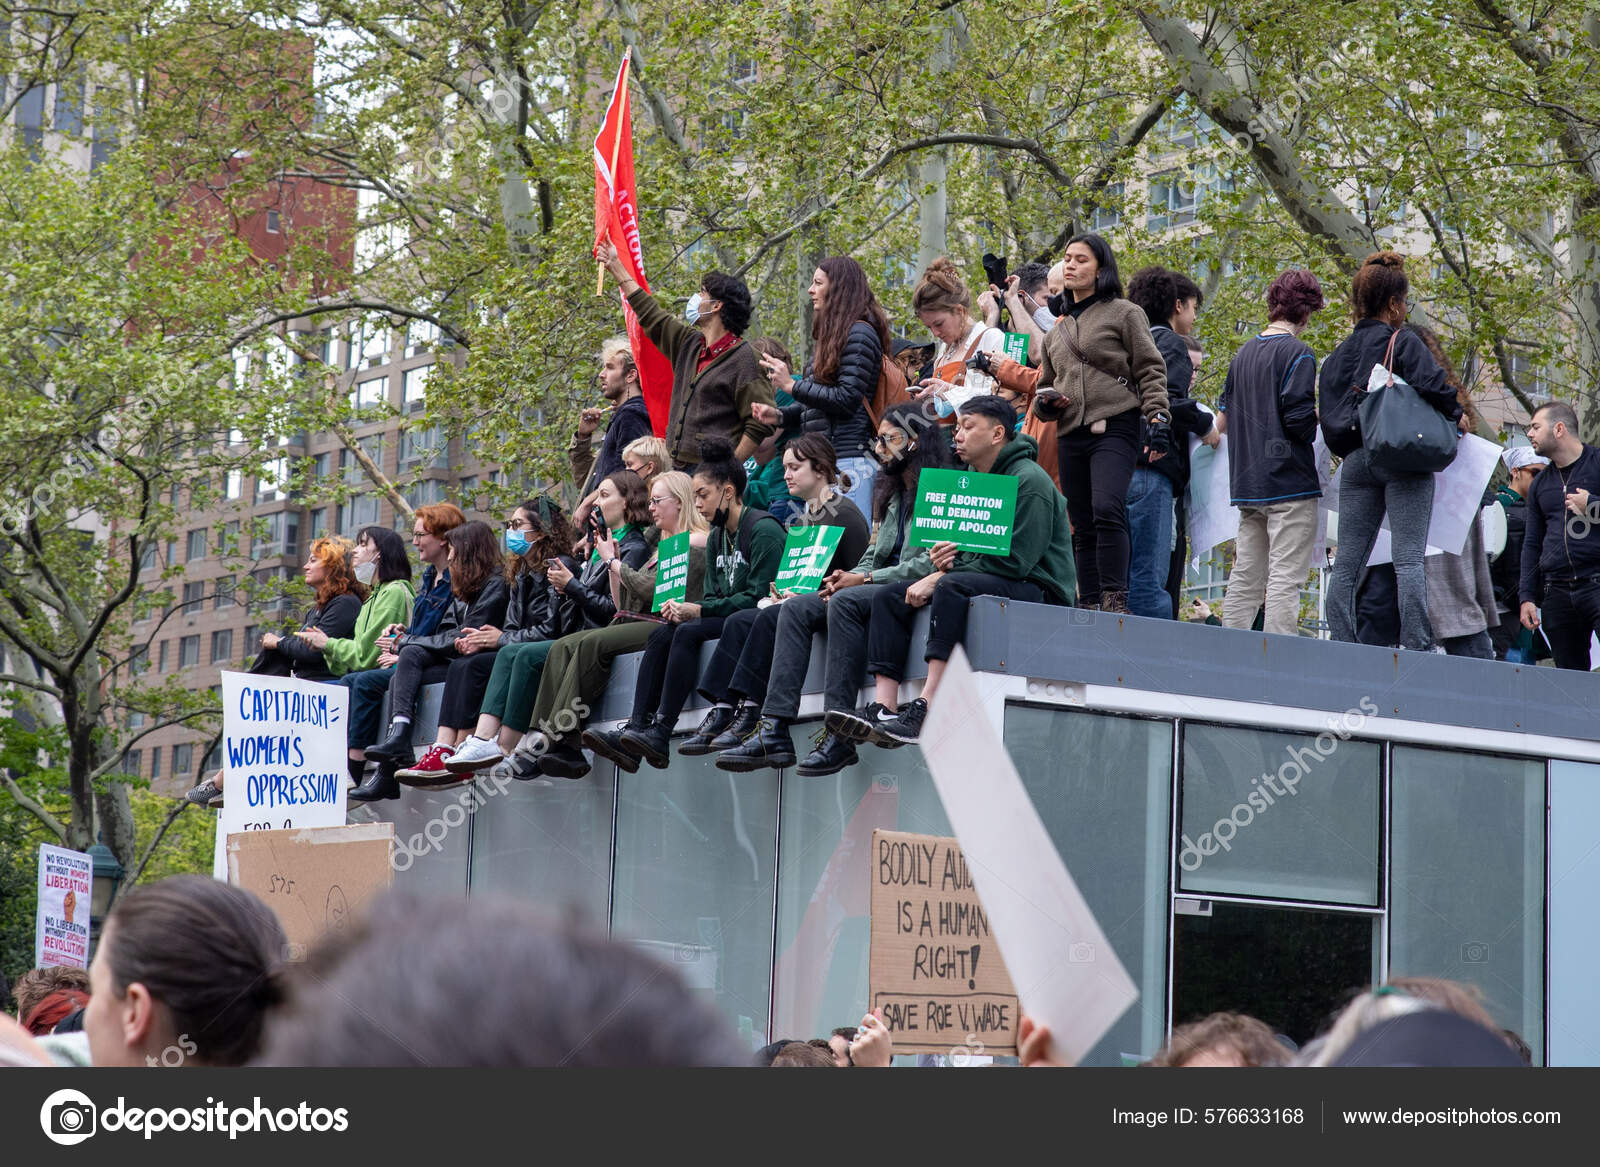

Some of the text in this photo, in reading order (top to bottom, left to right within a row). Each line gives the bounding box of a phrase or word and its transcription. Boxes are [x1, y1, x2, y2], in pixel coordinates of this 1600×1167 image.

[925, 492, 1003, 510] FREE ABORTION
[931, 505, 991, 521] ON DEMAND
[915, 517, 1009, 536] WITHOUT APOLOGY
[227, 728, 305, 769] WOMEN'S
[247, 772, 339, 809] OPPRESSION
[46, 853, 89, 871] NO REVOLUTION
[46, 863, 69, 876] WITHOUT
[879, 839, 938, 889] BODILY
[45, 873, 89, 894] LIBERATION
[45, 915, 87, 936] NO LIBERATION
[897, 899, 990, 940] IS A HUMAN
[45, 926, 66, 939] WITHOUT
[44, 935, 86, 957] REVOLUTION
[912, 944, 982, 991] RIGHT!
[883, 1002, 919, 1033] SAVE
[926, 1000, 953, 1033] ROE
